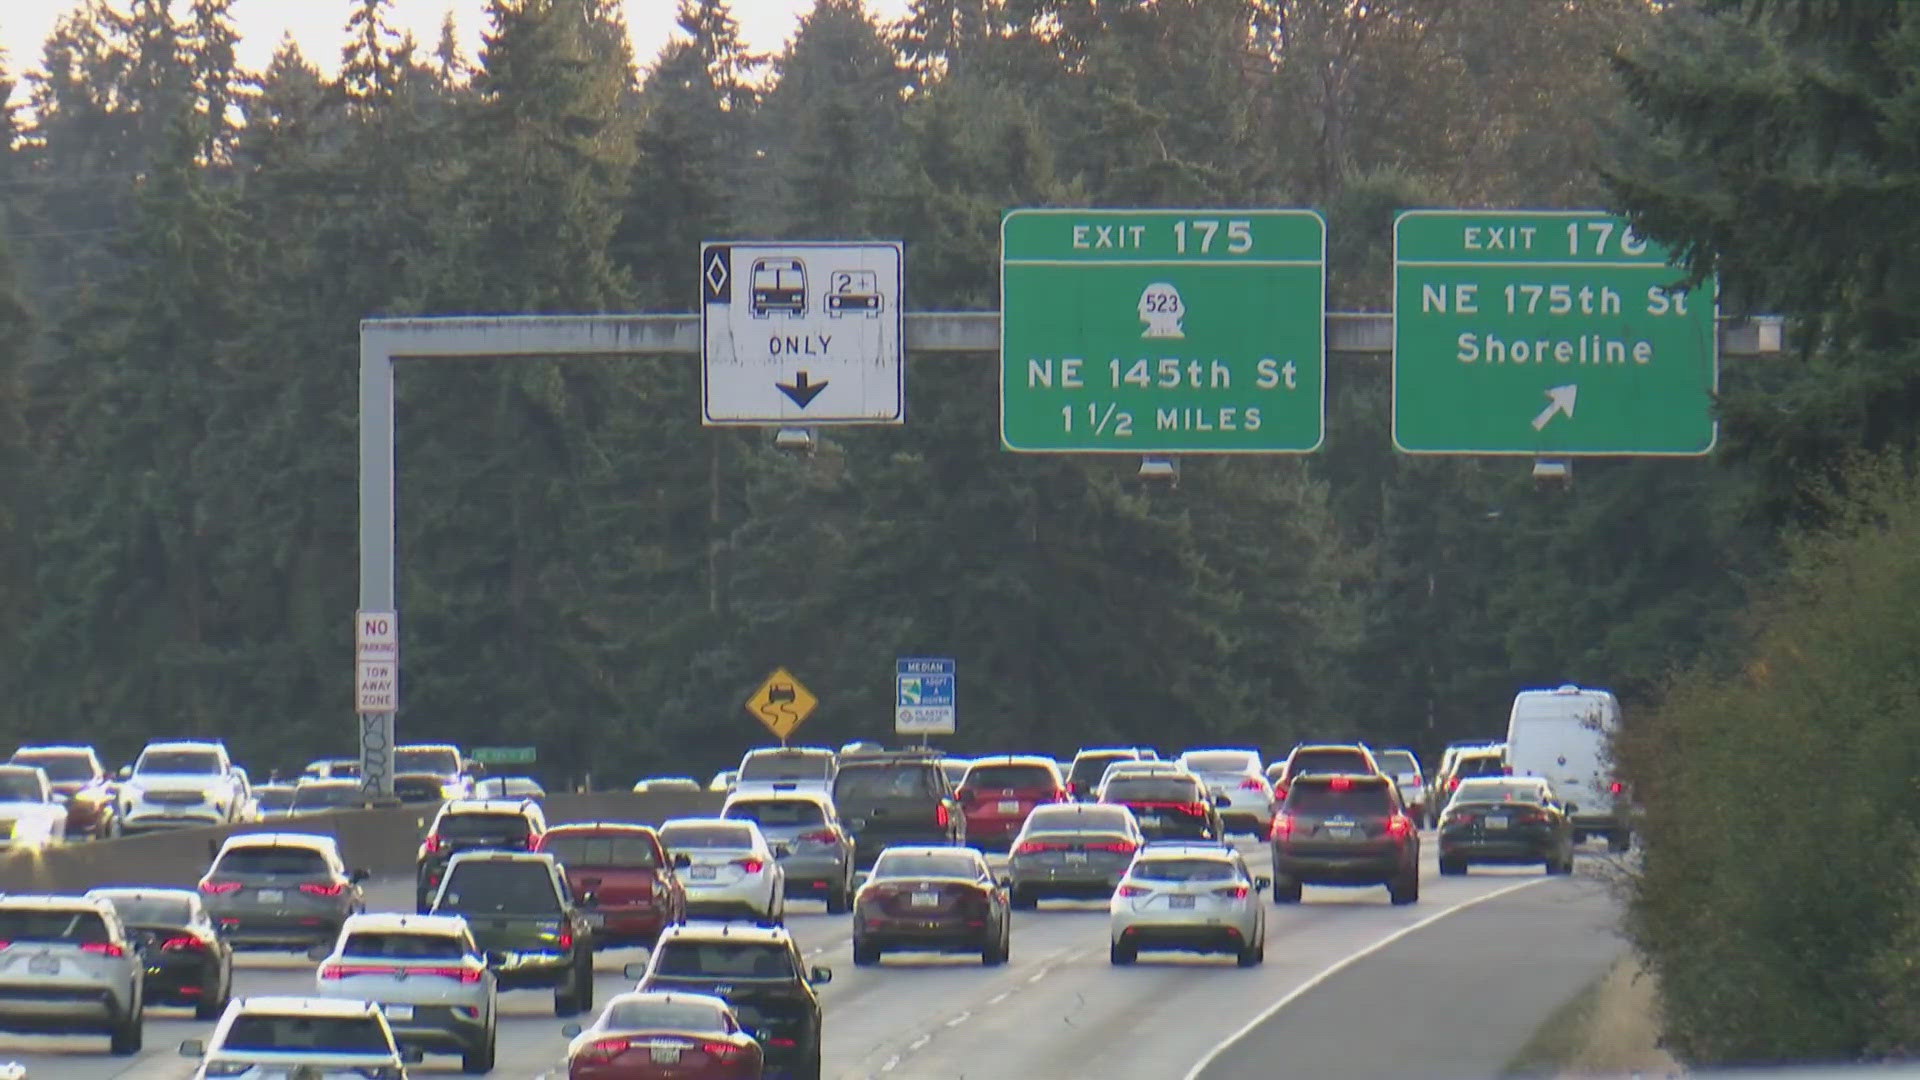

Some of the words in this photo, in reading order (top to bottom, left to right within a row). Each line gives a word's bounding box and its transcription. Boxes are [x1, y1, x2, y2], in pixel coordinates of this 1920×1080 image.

[1072, 225, 1146, 249] EXIT
[1173, 220, 1253, 253] 175
[1464, 226, 1537, 250] EXIT
[1146, 293, 1178, 313] 523
[1422, 284, 1478, 314] NE
[1504, 284, 1622, 315] 175th
[1646, 285, 1689, 316] St
[769, 335, 832, 355] ONLY
[1457, 332, 1653, 365] Shoreline
[1027, 358, 1084, 389] NE
[1109, 358, 1232, 389] 145th
[1255, 358, 1297, 389] St
[1062, 404, 1072, 433] 1
[1156, 407, 1262, 431] MILES
[365, 620, 388, 635] NO
[366, 666, 389, 677] TOW
[907, 662, 943, 673] MEDIAN
[362, 681, 392, 691] AWAY
[362, 694, 391, 705] ZONE
